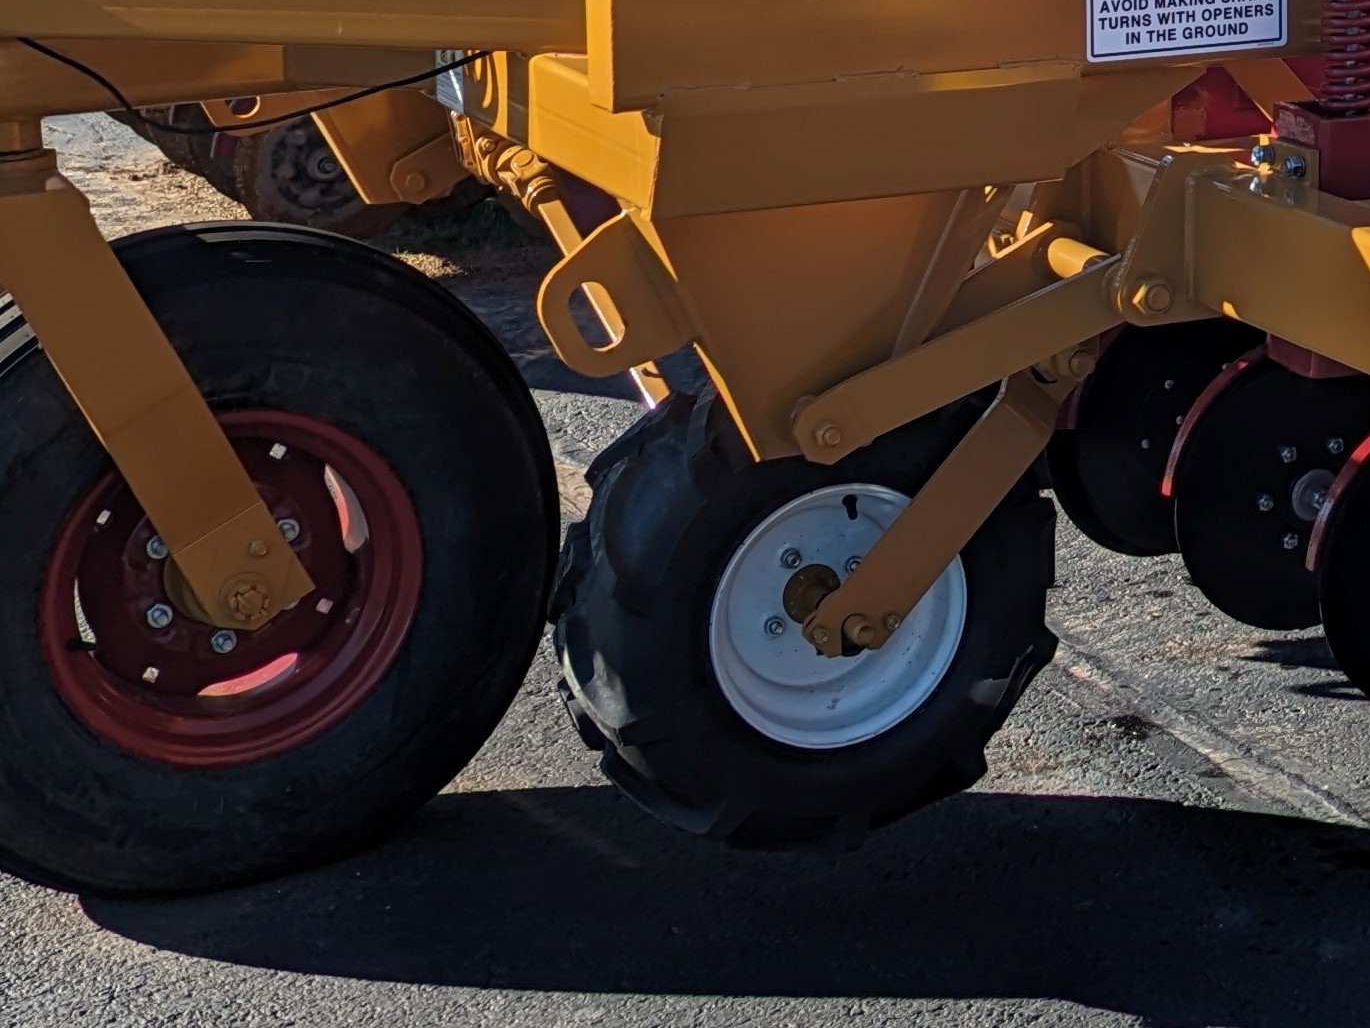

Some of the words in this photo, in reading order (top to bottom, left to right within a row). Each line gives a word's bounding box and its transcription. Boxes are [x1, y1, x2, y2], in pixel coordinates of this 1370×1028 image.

[1098, 13, 1152, 30] TURNS
[1157, 10, 1196, 26] WITH
[1201, 3, 1274, 22] OPENERS
[1126, 31, 1141, 45] IN
[1146, 28, 1177, 43] THE
[1182, 22, 1249, 40] GROUND
